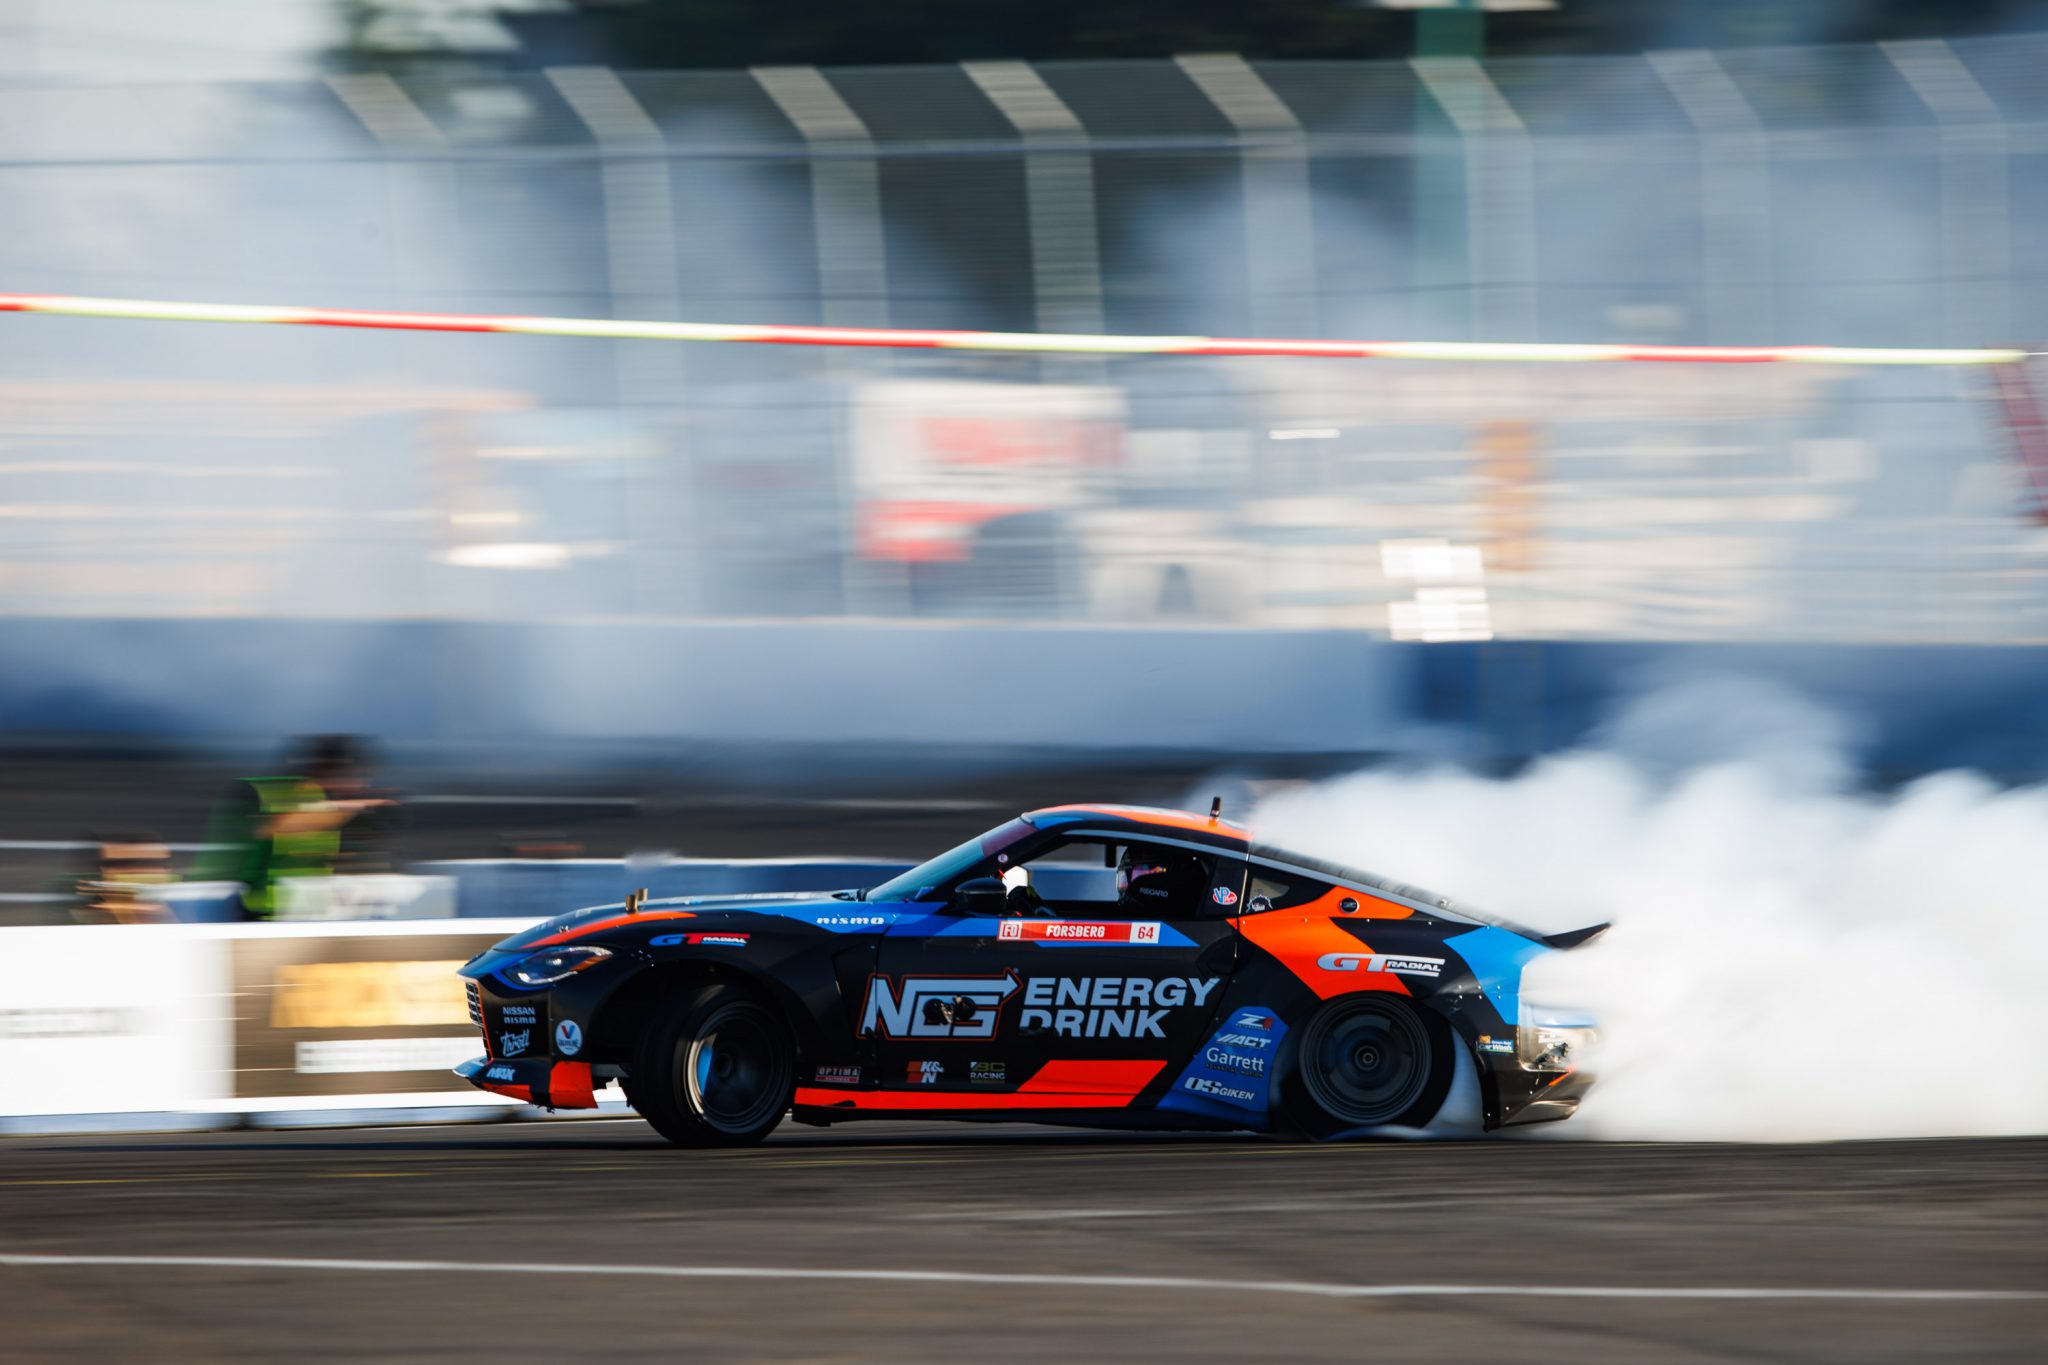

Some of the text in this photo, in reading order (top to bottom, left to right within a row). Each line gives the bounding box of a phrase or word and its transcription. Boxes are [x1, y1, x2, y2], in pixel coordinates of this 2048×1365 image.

[816, 916, 884, 925] nismo
[1045, 924, 1106, 938] FORSBERG
[1137, 926, 1154, 940] 64
[1317, 953, 1441, 972] GT RADIAL
[1024, 977, 1221, 1007] ENERGY
[502, 1006, 535, 1015] NISSAN
[1019, 1009, 1171, 1038] DRINK
[1206, 1047, 1265, 1072] Garrett
[818, 1067, 859, 1076] OPTIMA
[1219, 1087, 1255, 1101] GIKEN
